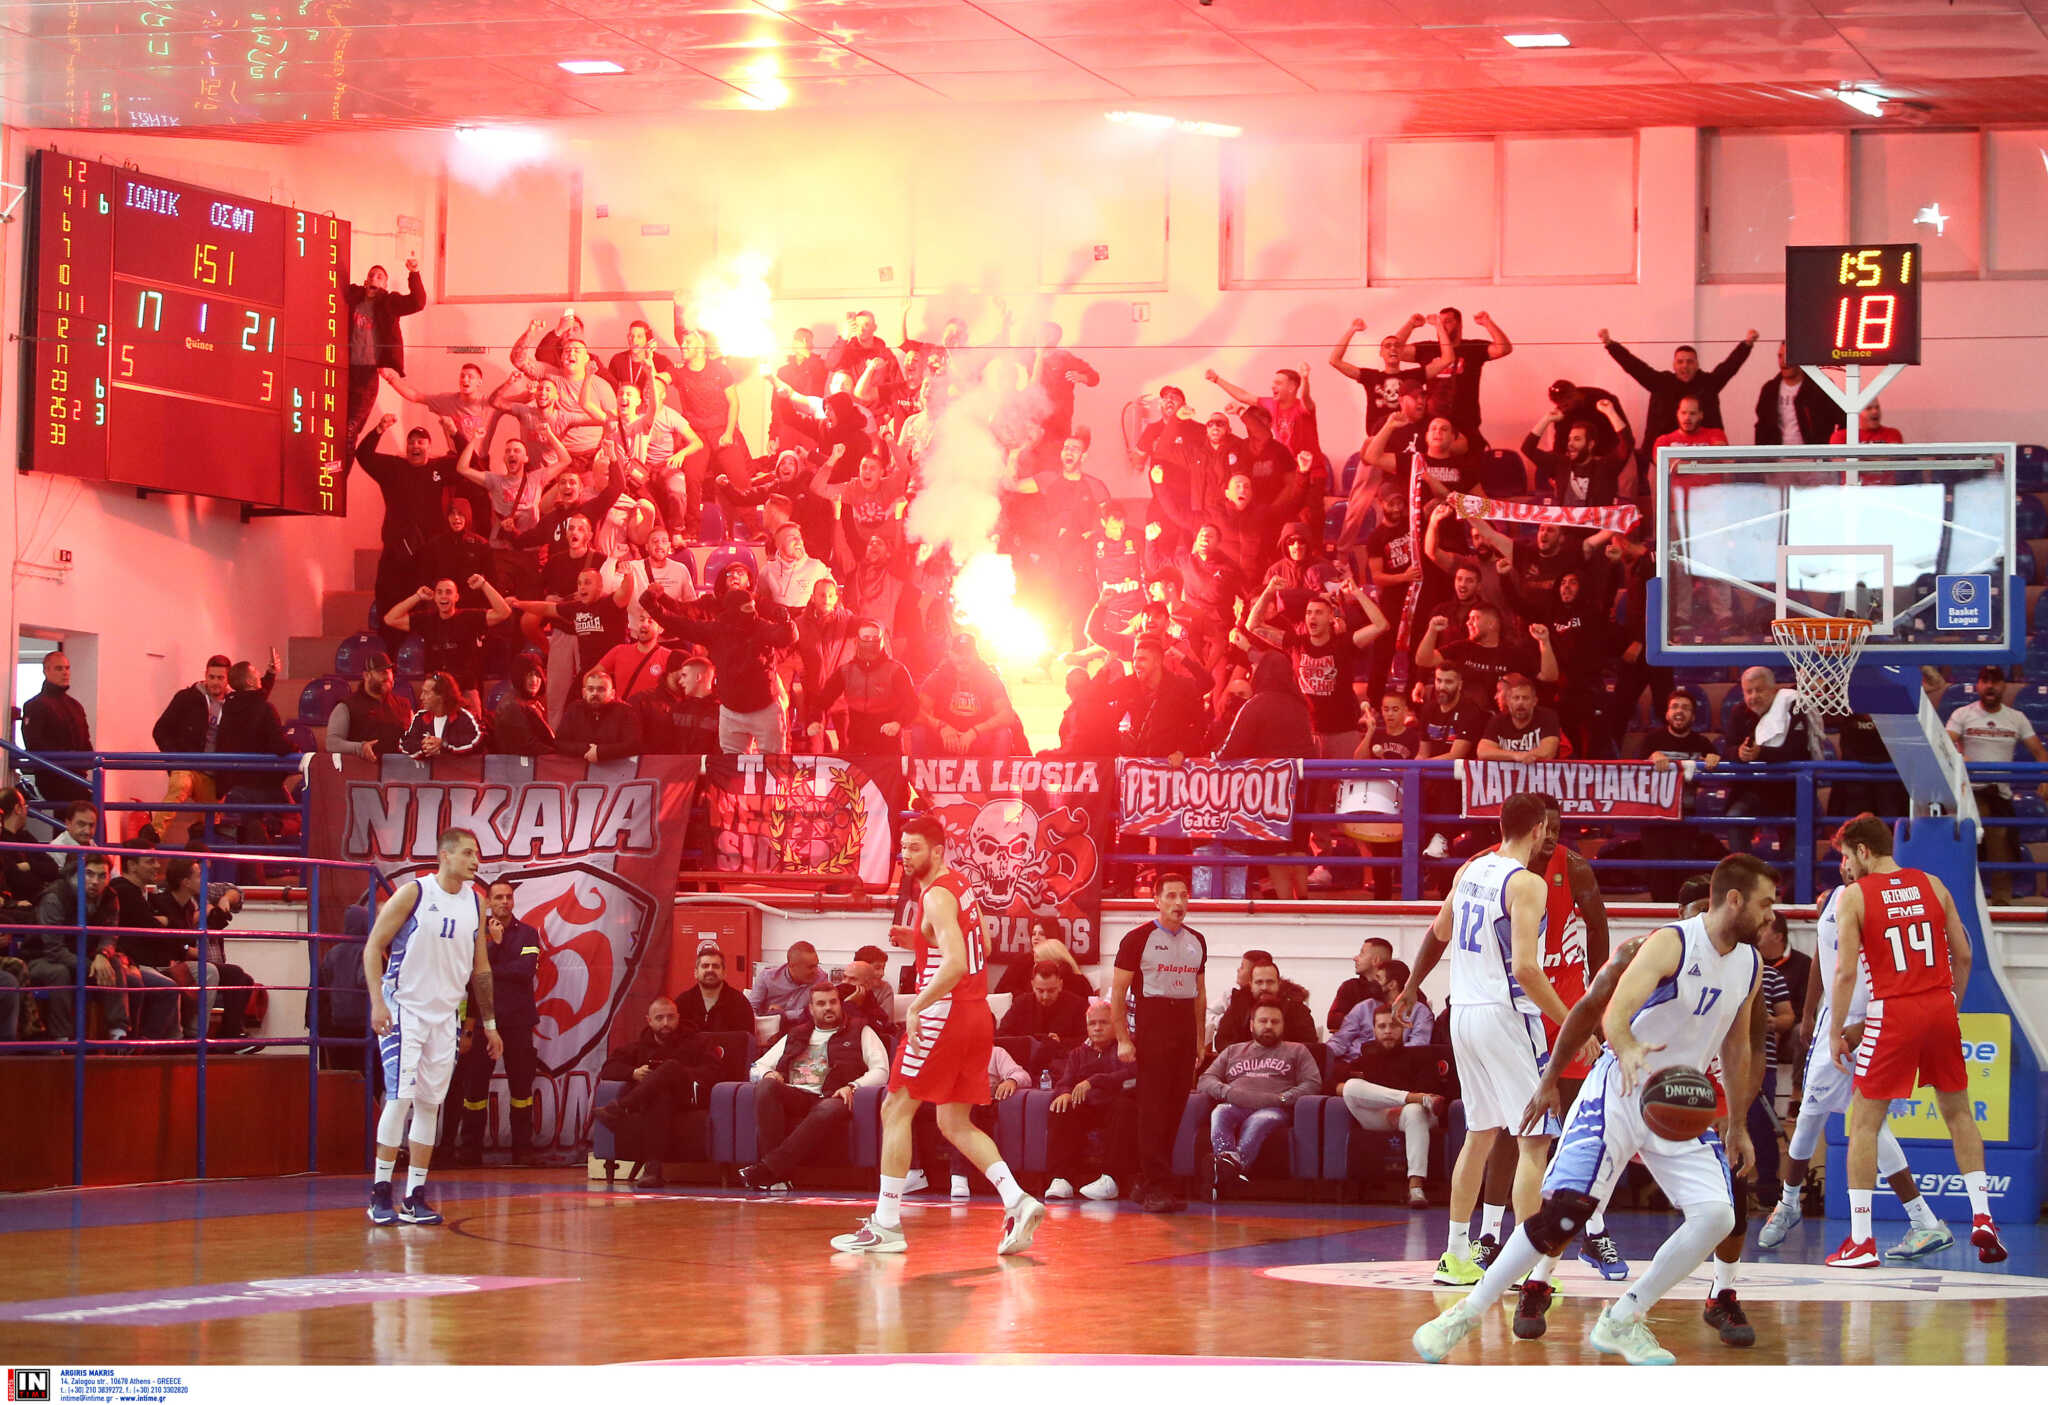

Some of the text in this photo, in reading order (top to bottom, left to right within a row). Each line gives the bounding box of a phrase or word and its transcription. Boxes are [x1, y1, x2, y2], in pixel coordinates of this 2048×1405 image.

[78, 161, 87, 182] 2
[63, 185, 109, 214] 4 1 6
[62, 212, 71, 232] 6
[296, 212, 337, 239] 3 1 0
[63, 237, 71, 258] 7
[296, 237, 337, 264] 7 3
[194, 243, 235, 286] 1:51
[1839, 250, 1912, 287] 1:51
[328, 270, 337, 289] 4
[58, 291, 85, 314] 11 1
[137, 290, 163, 332] 17
[328, 294, 336, 314] 5
[200, 303, 208, 333] 1
[328, 318, 336, 338] 9
[1835, 295, 1896, 349] 18
[57, 317, 107, 346] 12 2
[241, 310, 276, 353] 21
[56, 343, 69, 365] 17
[185, 336, 214, 352] Quince
[1832, 349, 1873, 359] Quince
[121, 345, 135, 377] 5
[51, 369, 68, 392] 23
[95, 377, 105, 398] 6
[260, 370, 274, 402] 3
[325, 368, 335, 388] 11
[72, 399, 82, 421] 2
[95, 403, 105, 425] 3
[293, 387, 335, 413] 6 1 14
[50, 422, 67, 445] 33
[293, 411, 335, 438] 5 1 16
[319, 441, 334, 462] 21
[319, 490, 333, 512] 77
[1948, 607, 1979, 616] Basket
[1948, 616, 1979, 626] League
[914, 759, 1100, 793] NEA LIOSIA
[1125, 766, 1291, 816] PETROUPOLI
[1600, 800, 1615, 813] 7
[439, 917, 456, 939] 11
[1459, 900, 1485, 953] 12
[1884, 921, 1935, 972] 14
[1693, 986, 1723, 1016] 17
